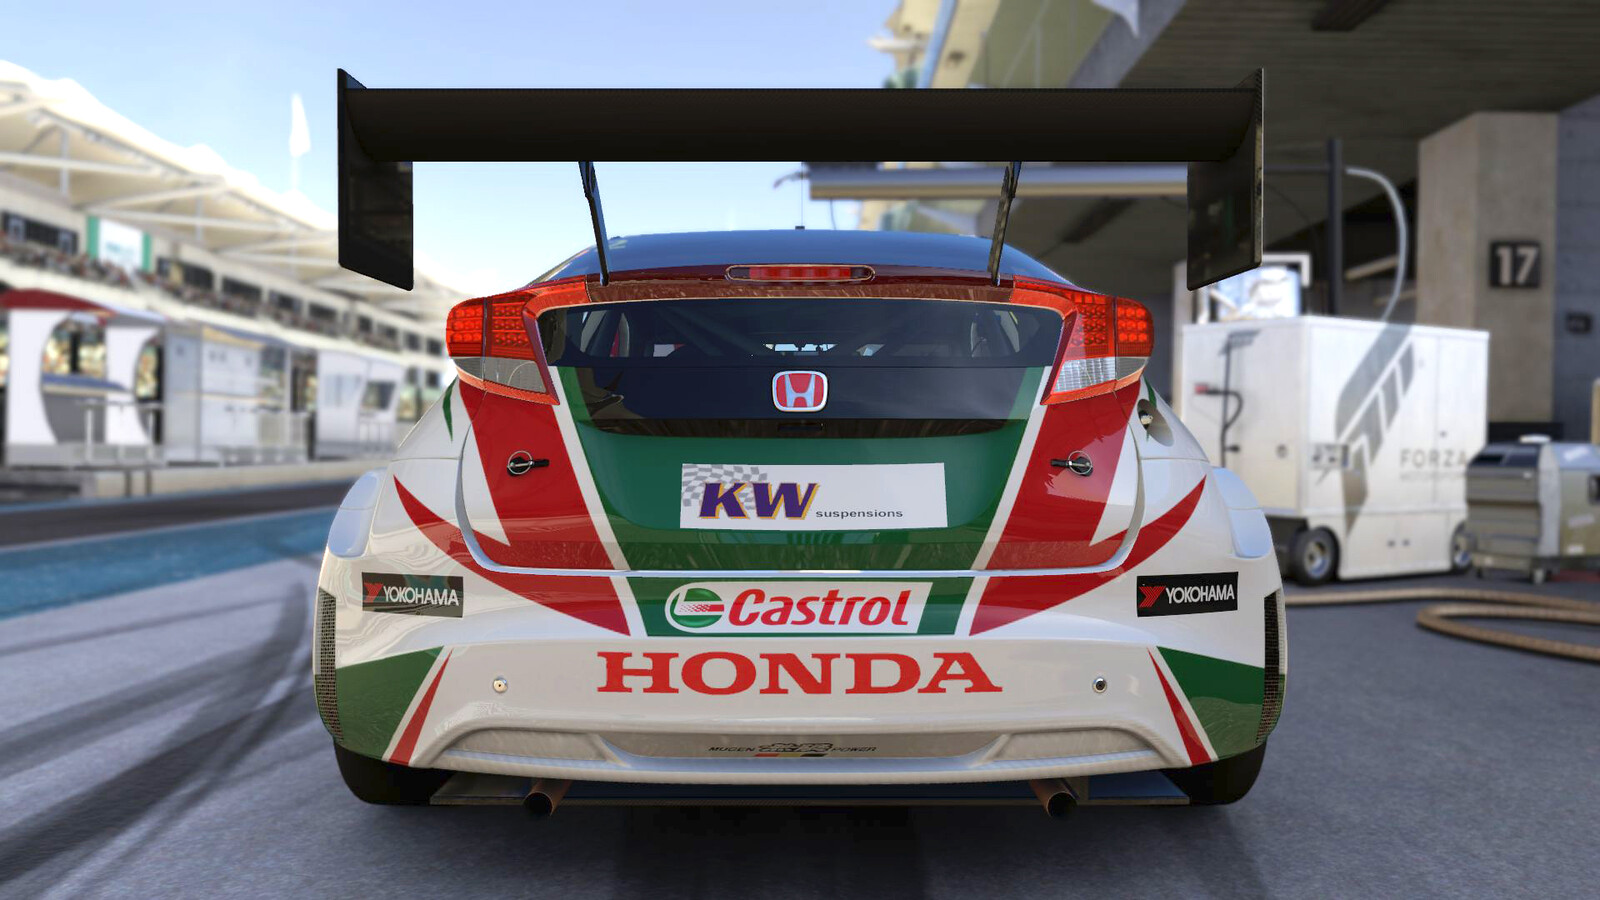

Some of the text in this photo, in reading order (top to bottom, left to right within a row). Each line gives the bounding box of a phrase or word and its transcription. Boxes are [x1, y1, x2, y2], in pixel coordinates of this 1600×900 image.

[1496, 246, 1539, 285] 17
[1400, 448, 1468, 468] FORZA
[699, 482, 820, 520] KW
[816, 509, 904, 520] suspensions
[383, 585, 460, 606] YOKOHAMA
[728, 588, 912, 627] Castrol
[1165, 584, 1236, 604] YOKOHAMA
[596, 651, 1003, 695] HONDA
